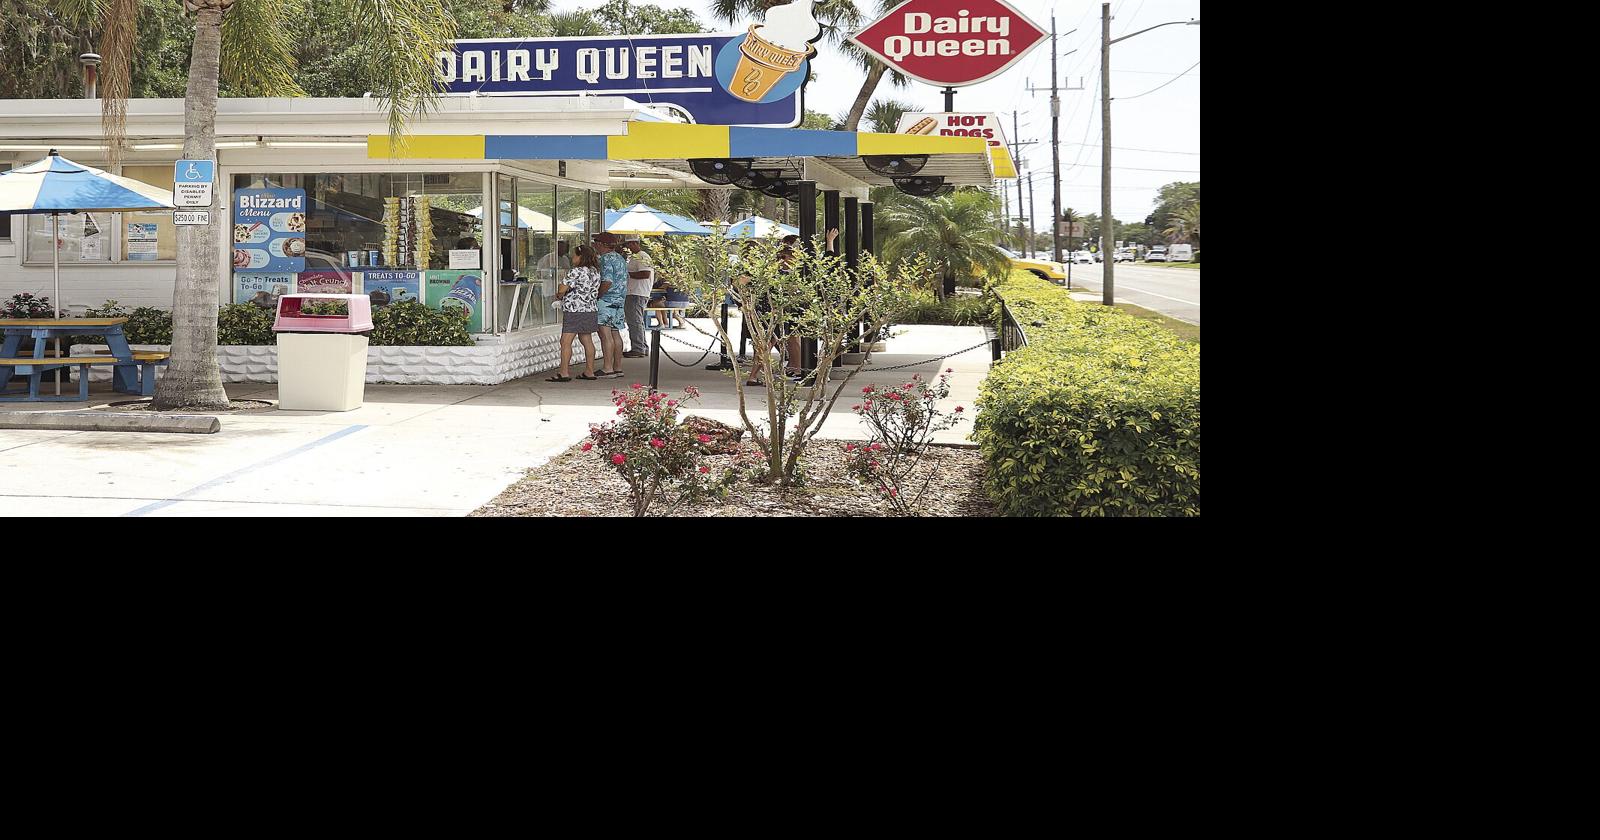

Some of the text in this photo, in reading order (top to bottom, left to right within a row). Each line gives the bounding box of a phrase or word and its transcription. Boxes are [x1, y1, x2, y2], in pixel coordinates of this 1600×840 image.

[904, 9, 1010, 36] Dairy
[883, 35, 1010, 61] Queen
[436, 45, 712, 84] DAIRY QUEEN
[947, 115, 986, 127] HOT
[240, 194, 301, 208] Blizzard
[197, 214, 208, 222] FINE
[239, 208, 271, 217] Menu
[319, 277, 350, 287] Crunch
